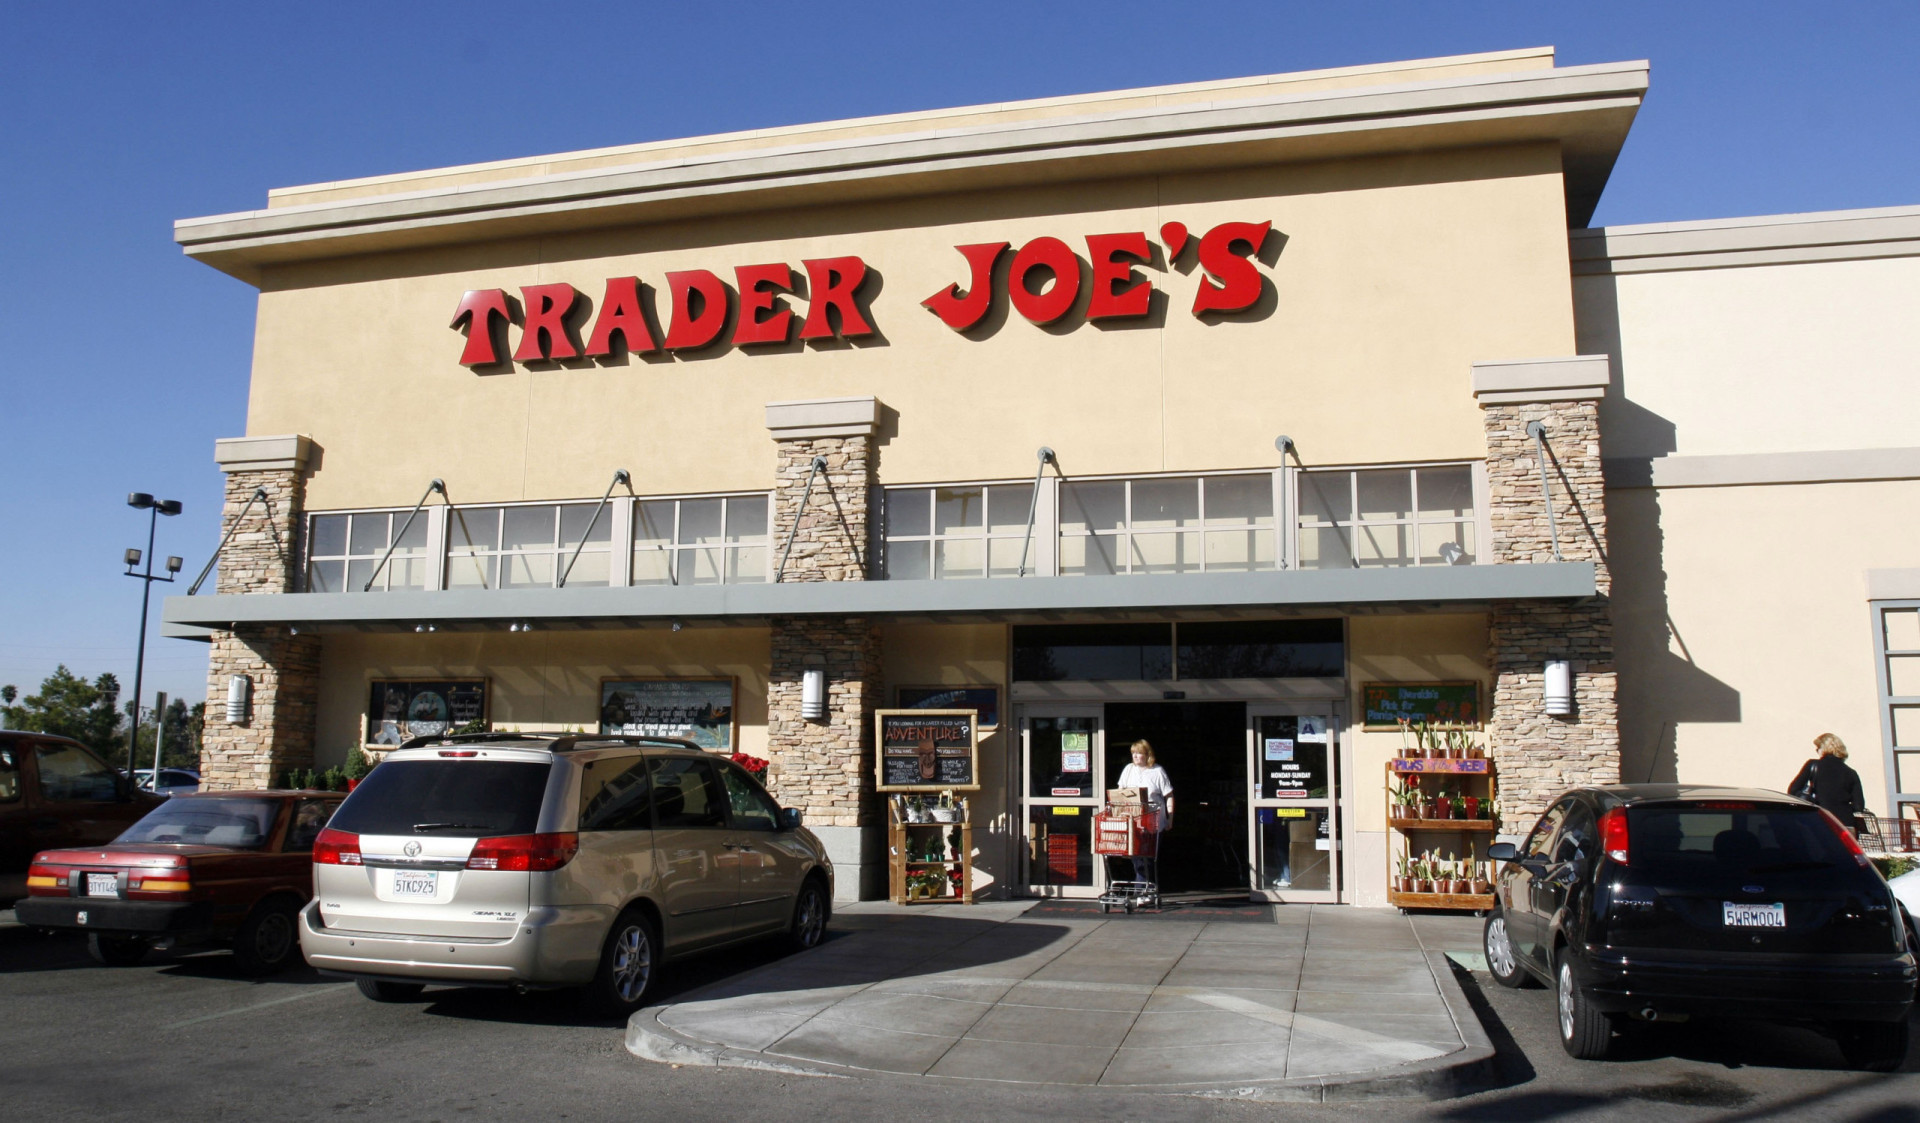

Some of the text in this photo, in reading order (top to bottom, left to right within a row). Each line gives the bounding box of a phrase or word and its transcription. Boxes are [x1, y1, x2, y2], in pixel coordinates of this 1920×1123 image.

[449, 219, 1272, 366] TRADER JOE'S
[395, 880, 435, 894] 5TKC925
[1726, 911, 1783, 927] 5WRM004
